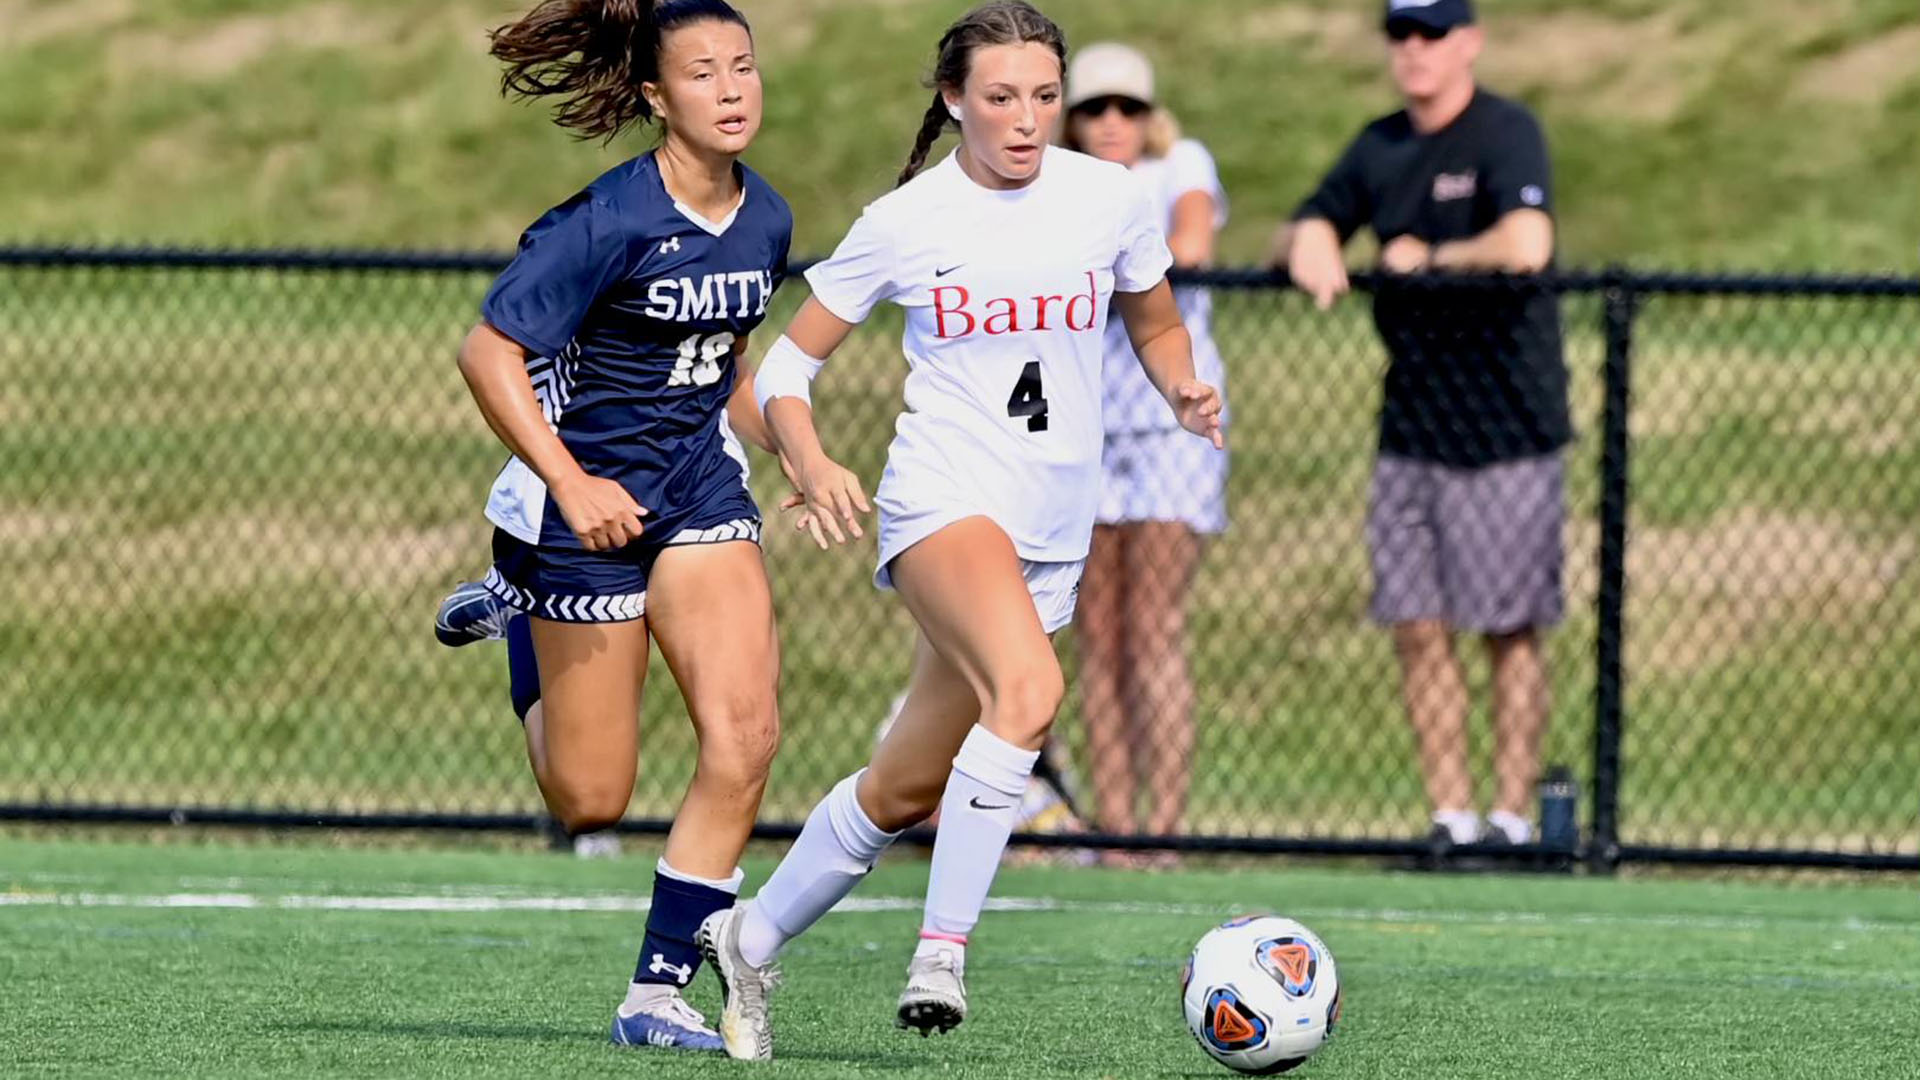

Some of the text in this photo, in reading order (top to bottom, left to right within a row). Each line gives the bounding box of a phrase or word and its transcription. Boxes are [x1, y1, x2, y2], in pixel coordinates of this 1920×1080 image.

[645, 269, 772, 322] SMITH
[928, 269, 1098, 339] Bard
[1007, 361, 1049, 432] 4
